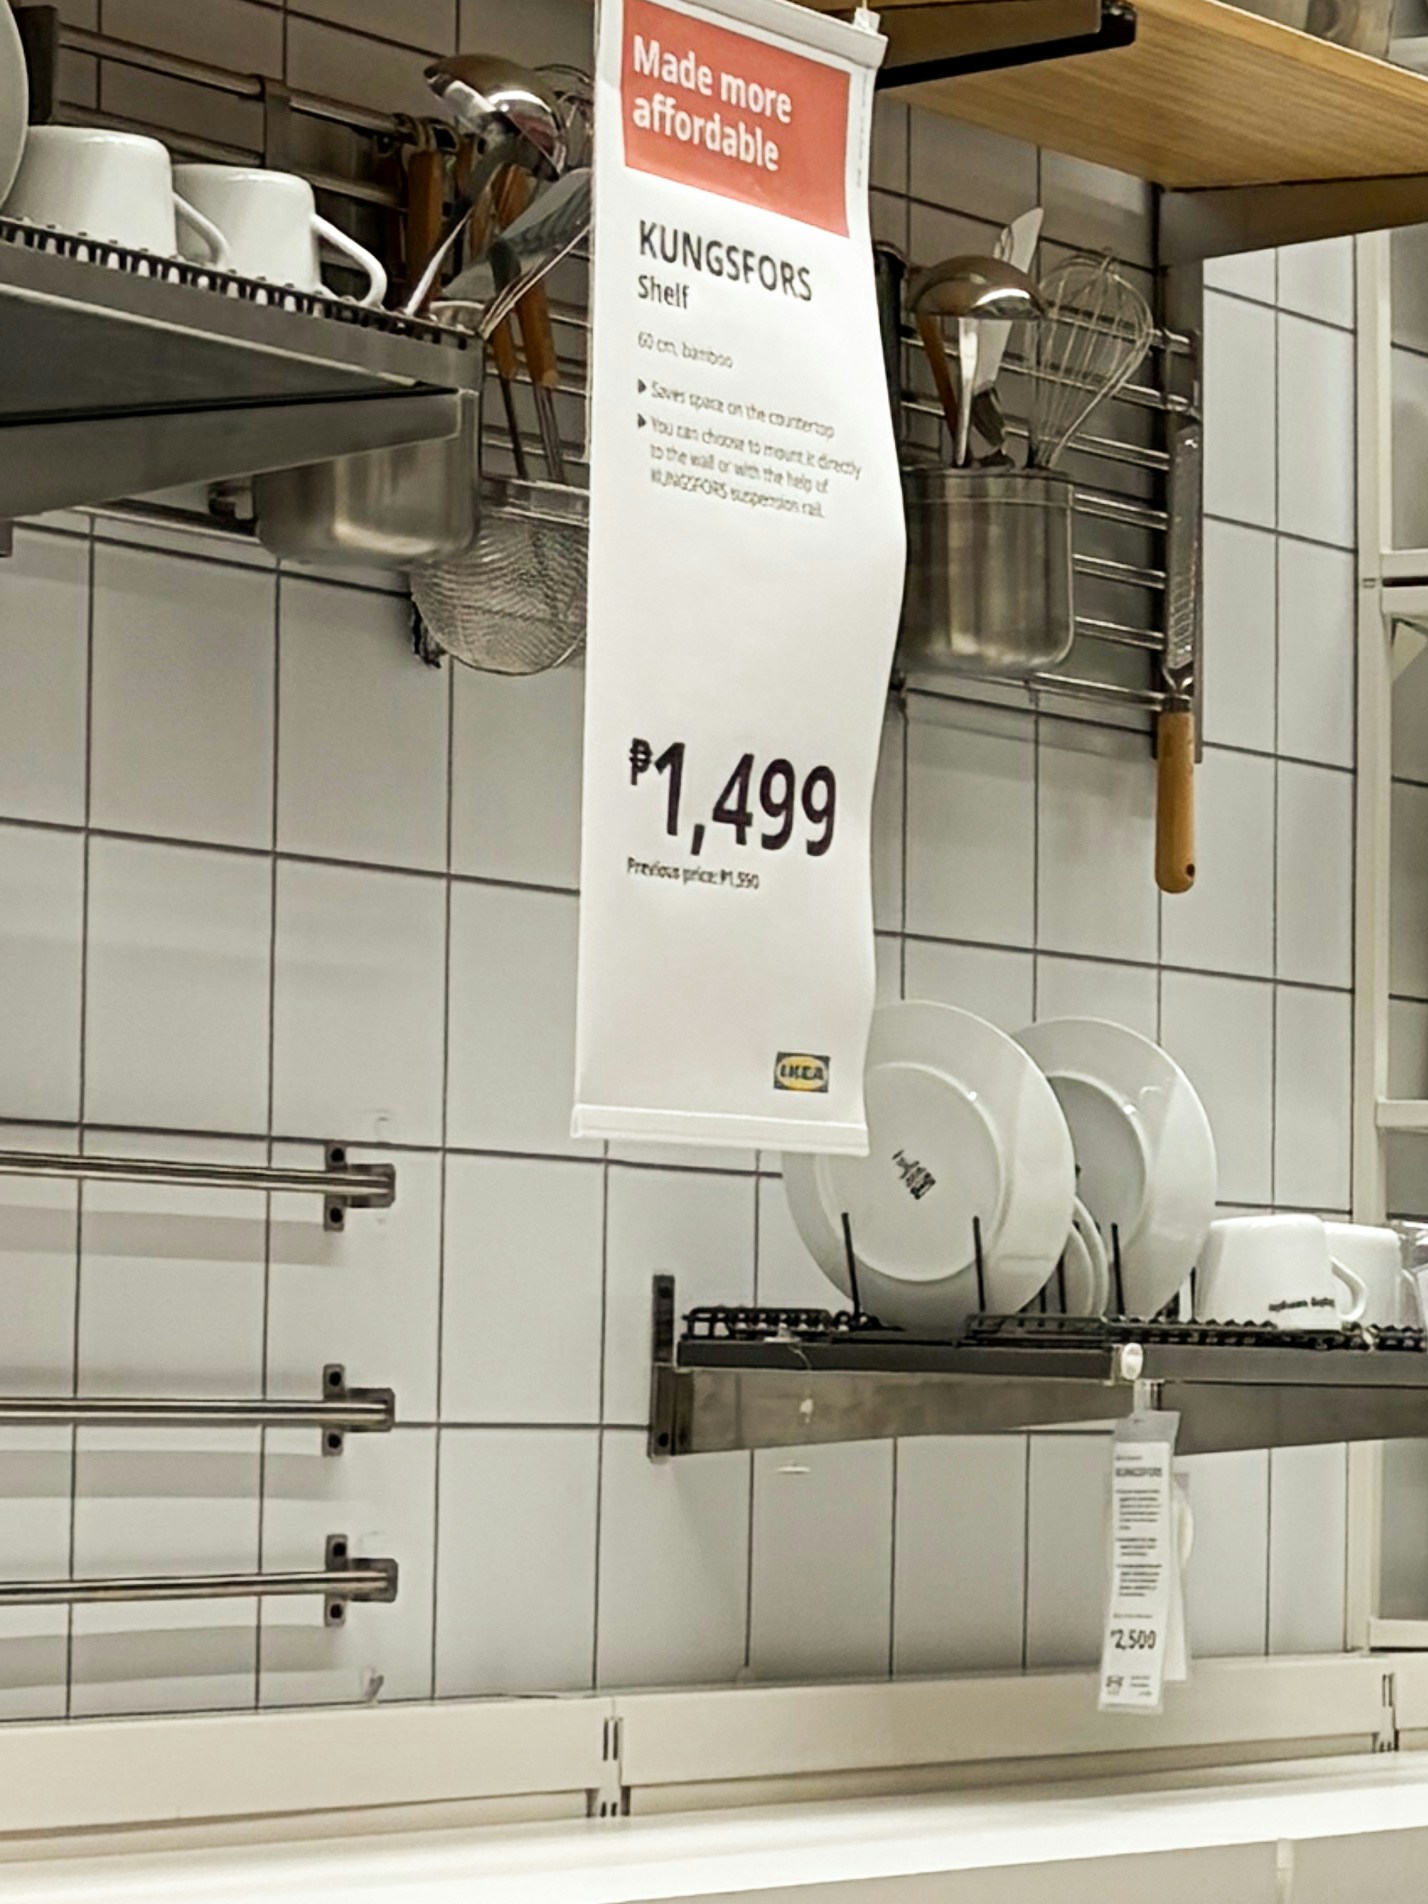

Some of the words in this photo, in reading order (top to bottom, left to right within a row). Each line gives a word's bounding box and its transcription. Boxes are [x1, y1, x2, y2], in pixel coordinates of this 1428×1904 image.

[633, 34, 713, 97] Made
[720, 70, 793, 124] more
[632, 92, 780, 172] affordable
[639, 219, 812, 302] KUNGSFORS
[638, 274, 690, 310] Shelf
[682, 342, 733, 369] bamboo
[651, 380, 686, 404] Saves
[689, 393, 724, 413] space
[728, 402, 744, 417] on
[746, 404, 766, 424] the
[768, 412, 835, 441] countertop
[650, 416, 673, 437] You
[676, 425, 699, 442] can
[702, 427, 745, 452] choose
[748, 439, 761, 456] to
[763, 444, 805, 466] mount
[650, 443, 665, 461] to
[666, 445, 687, 466] the
[690, 453, 715, 470] wall
[718, 459, 732, 474] or
[734, 462, 762, 481] with
[763, 465, 784, 488] the
[786, 470, 812, 493] help
[650, 467, 728, 500] KUNGSFORS
[627, 856, 680, 881] Previous
